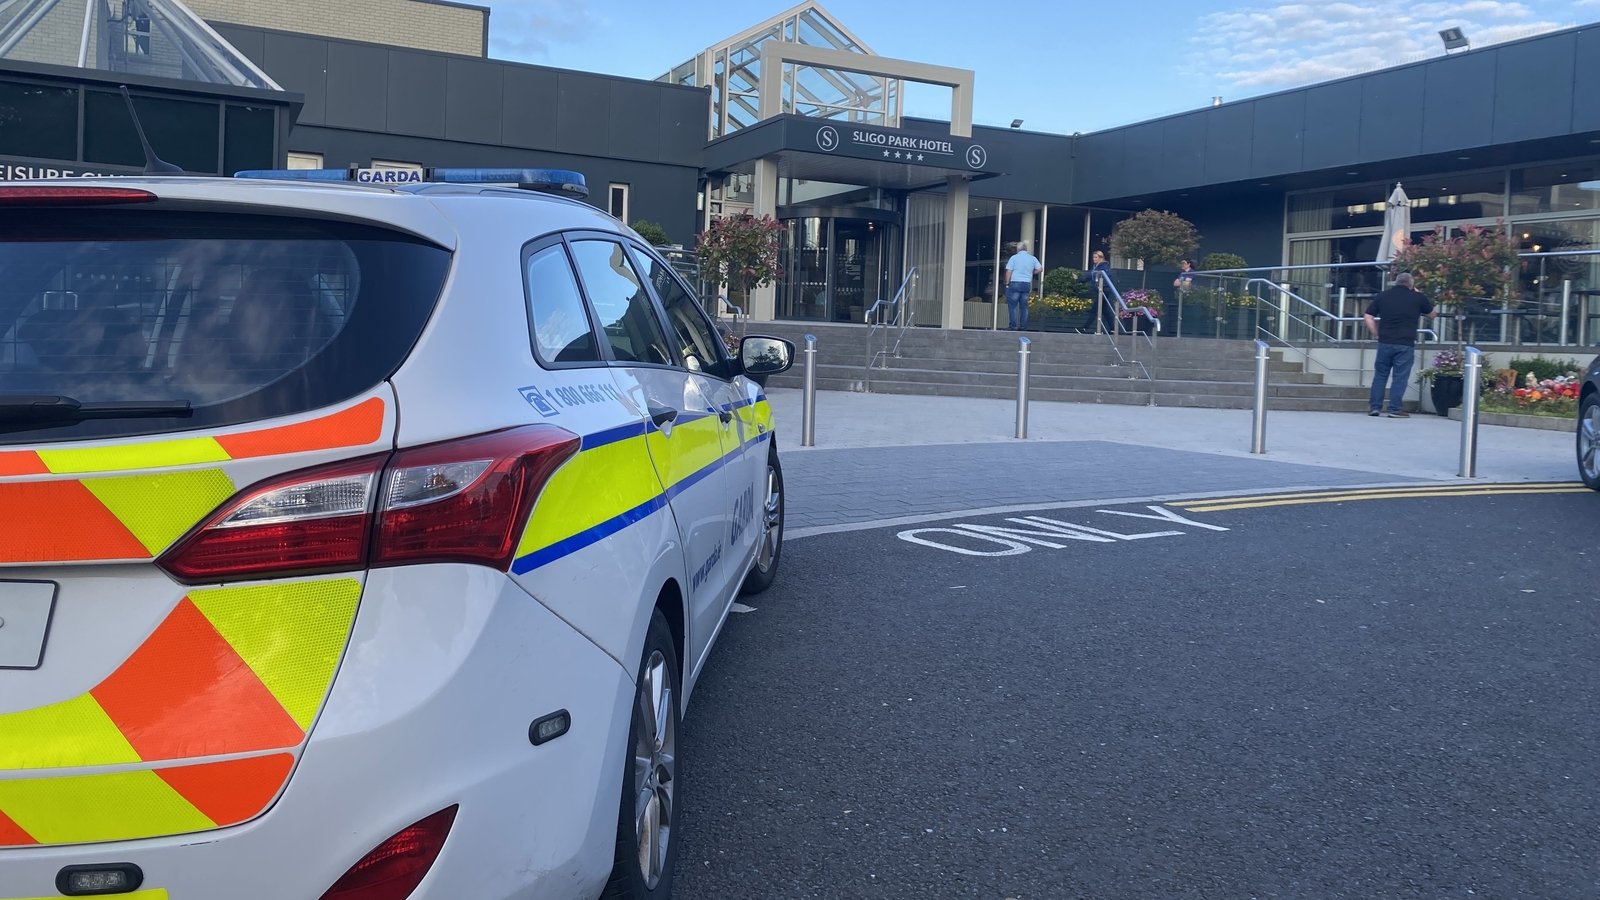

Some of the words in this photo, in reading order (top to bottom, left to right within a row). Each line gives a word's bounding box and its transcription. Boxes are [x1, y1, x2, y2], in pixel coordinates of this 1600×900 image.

[853, 130, 886, 145] SLIGO
[888, 134, 917, 149] PARK
[919, 139, 954, 153] HOTEL
[359, 170, 421, 183] GARDA
[555, 385, 586, 407] 800
[897, 505, 1231, 557] ONLY
